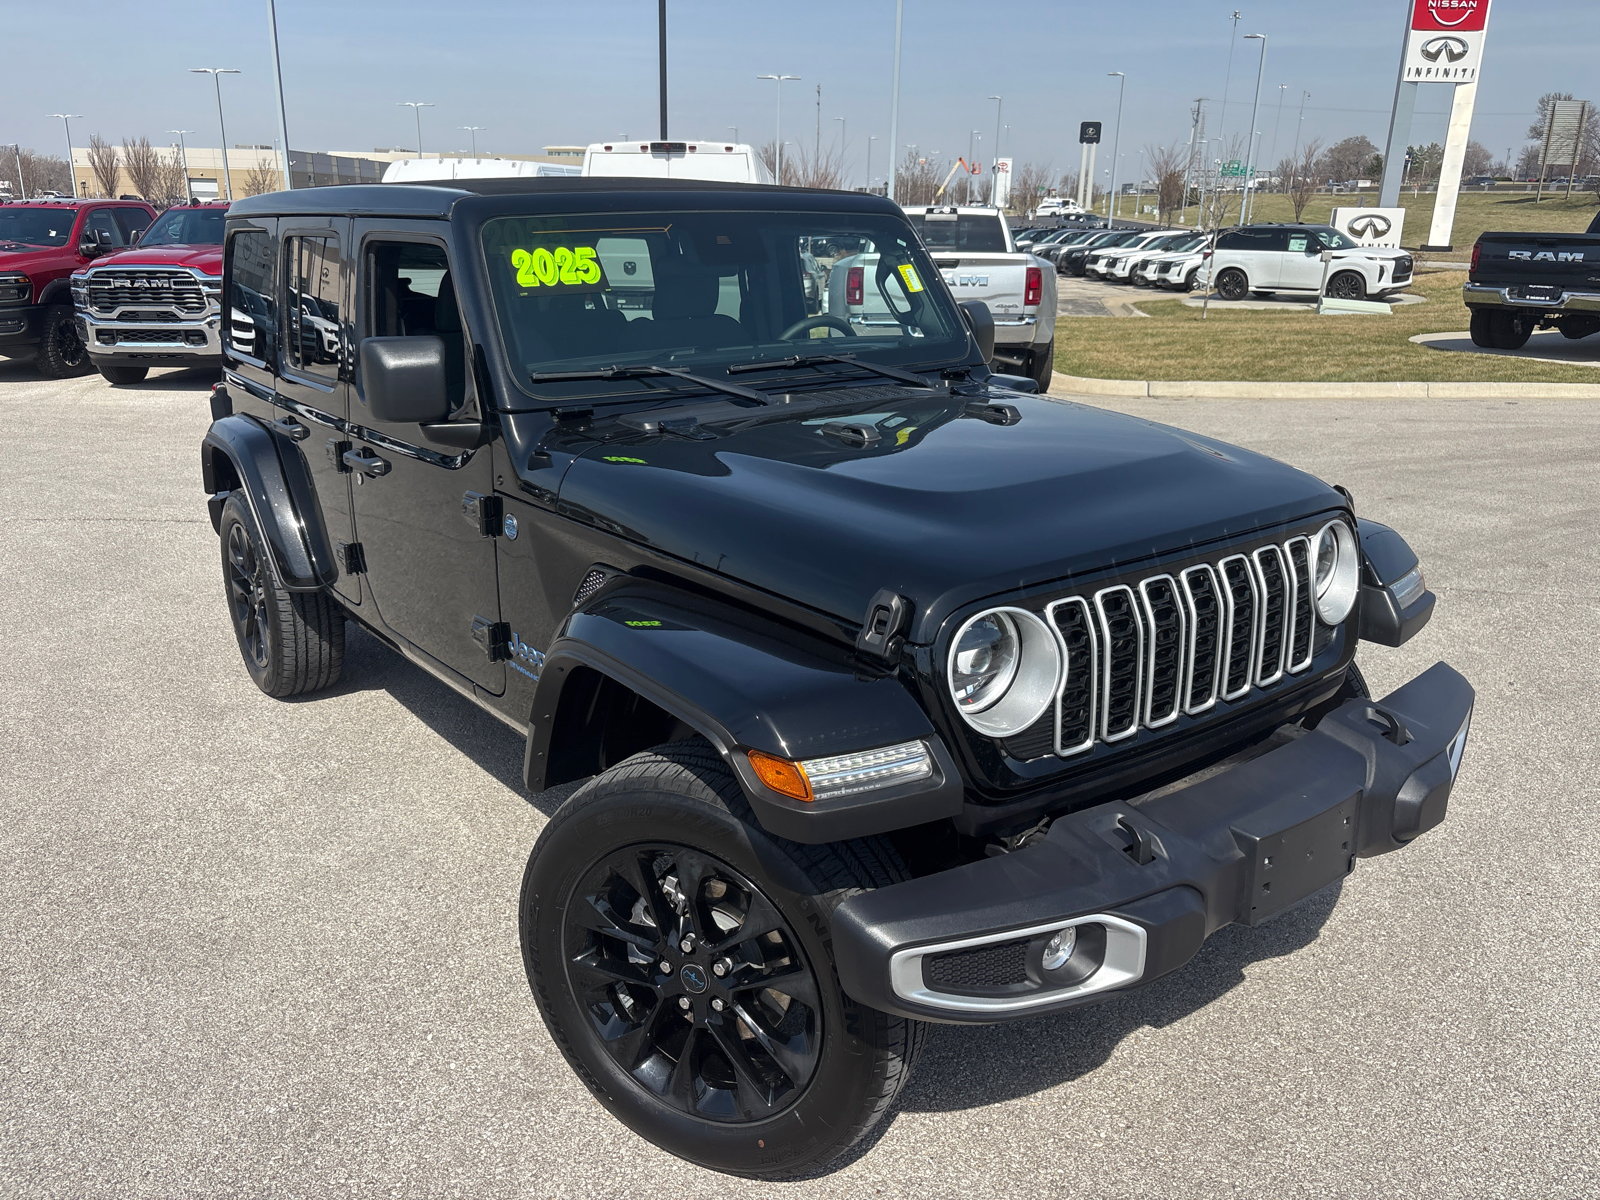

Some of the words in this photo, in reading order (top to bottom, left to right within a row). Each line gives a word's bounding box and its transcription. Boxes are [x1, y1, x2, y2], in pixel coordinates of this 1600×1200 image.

[1428, 0, 1477, 8] NISSAN
[1407, 67, 1476, 78] INFINITI
[1508, 250, 1584, 262] RAM
[511, 247, 602, 288] 2025
[114, 279, 169, 287] RAM
